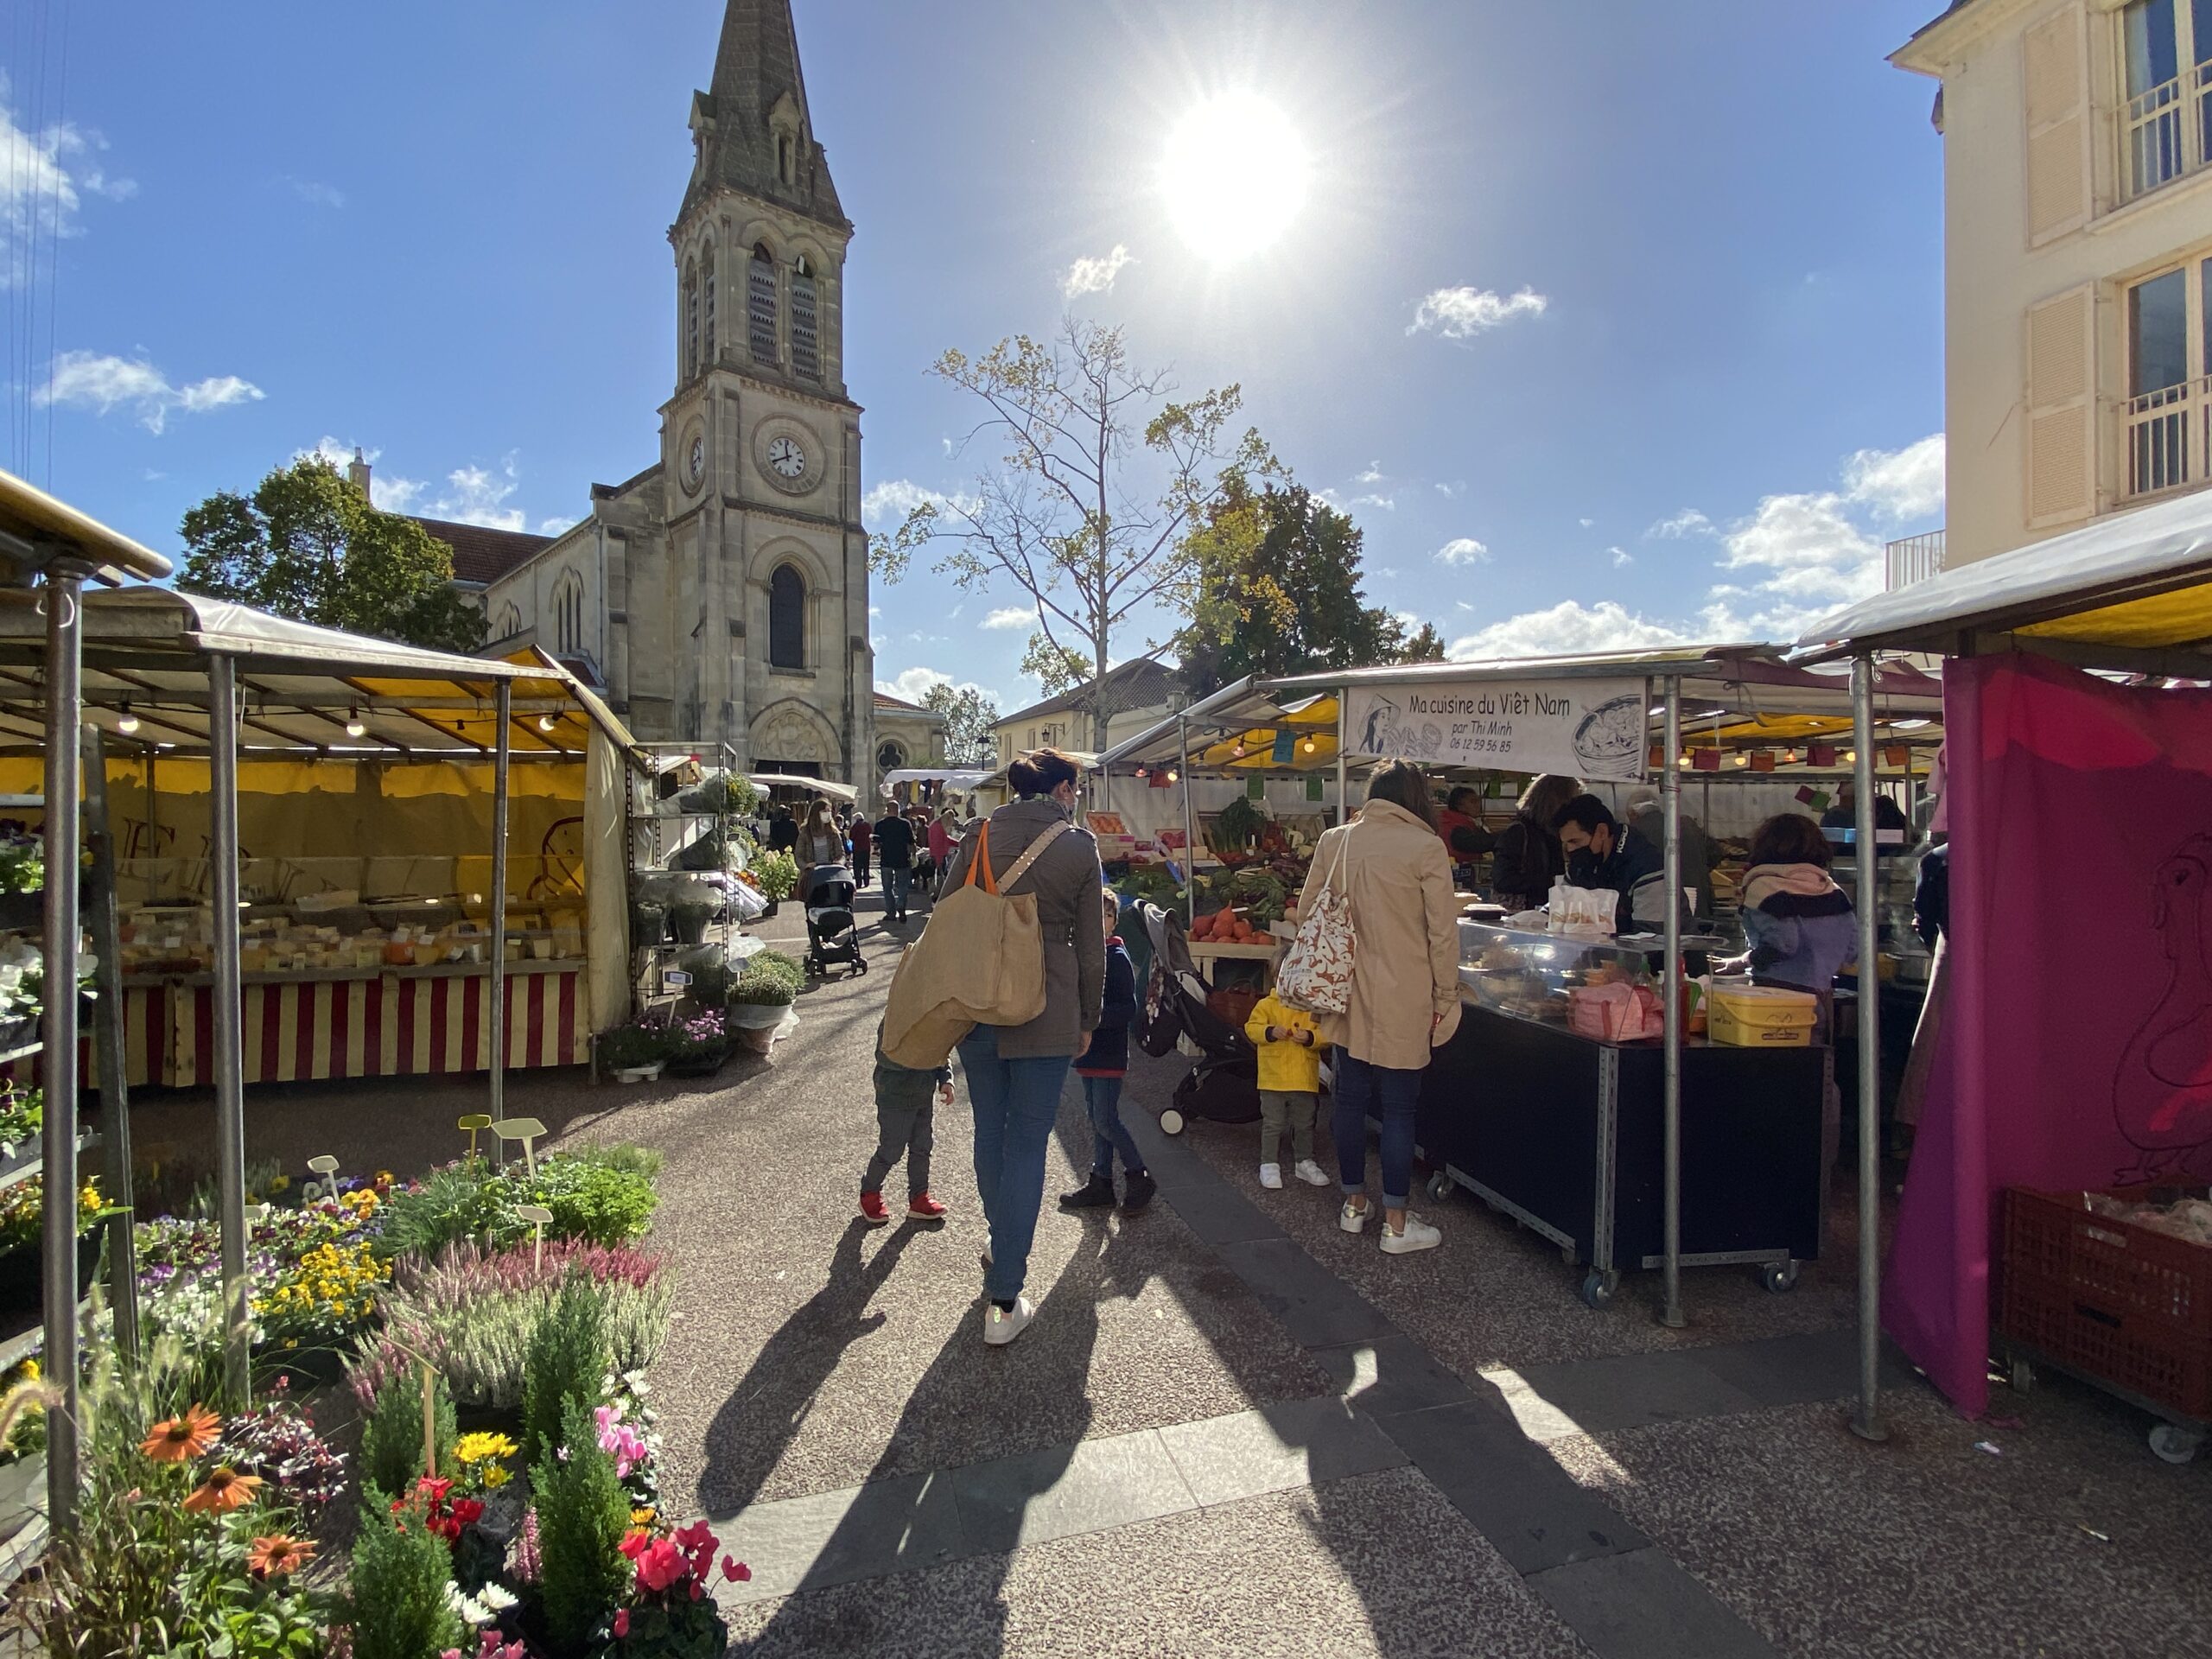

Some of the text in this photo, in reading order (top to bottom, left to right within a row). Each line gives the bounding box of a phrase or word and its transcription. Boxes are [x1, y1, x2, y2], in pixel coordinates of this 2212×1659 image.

[1409, 695, 1427, 713] Ma
[1430, 695, 1474, 715] cuisine
[1478, 693, 1494, 715] du
[1451, 720, 1512, 737] par Thi Minh
[1450, 737, 1511, 753] 06 12 59 56 85
